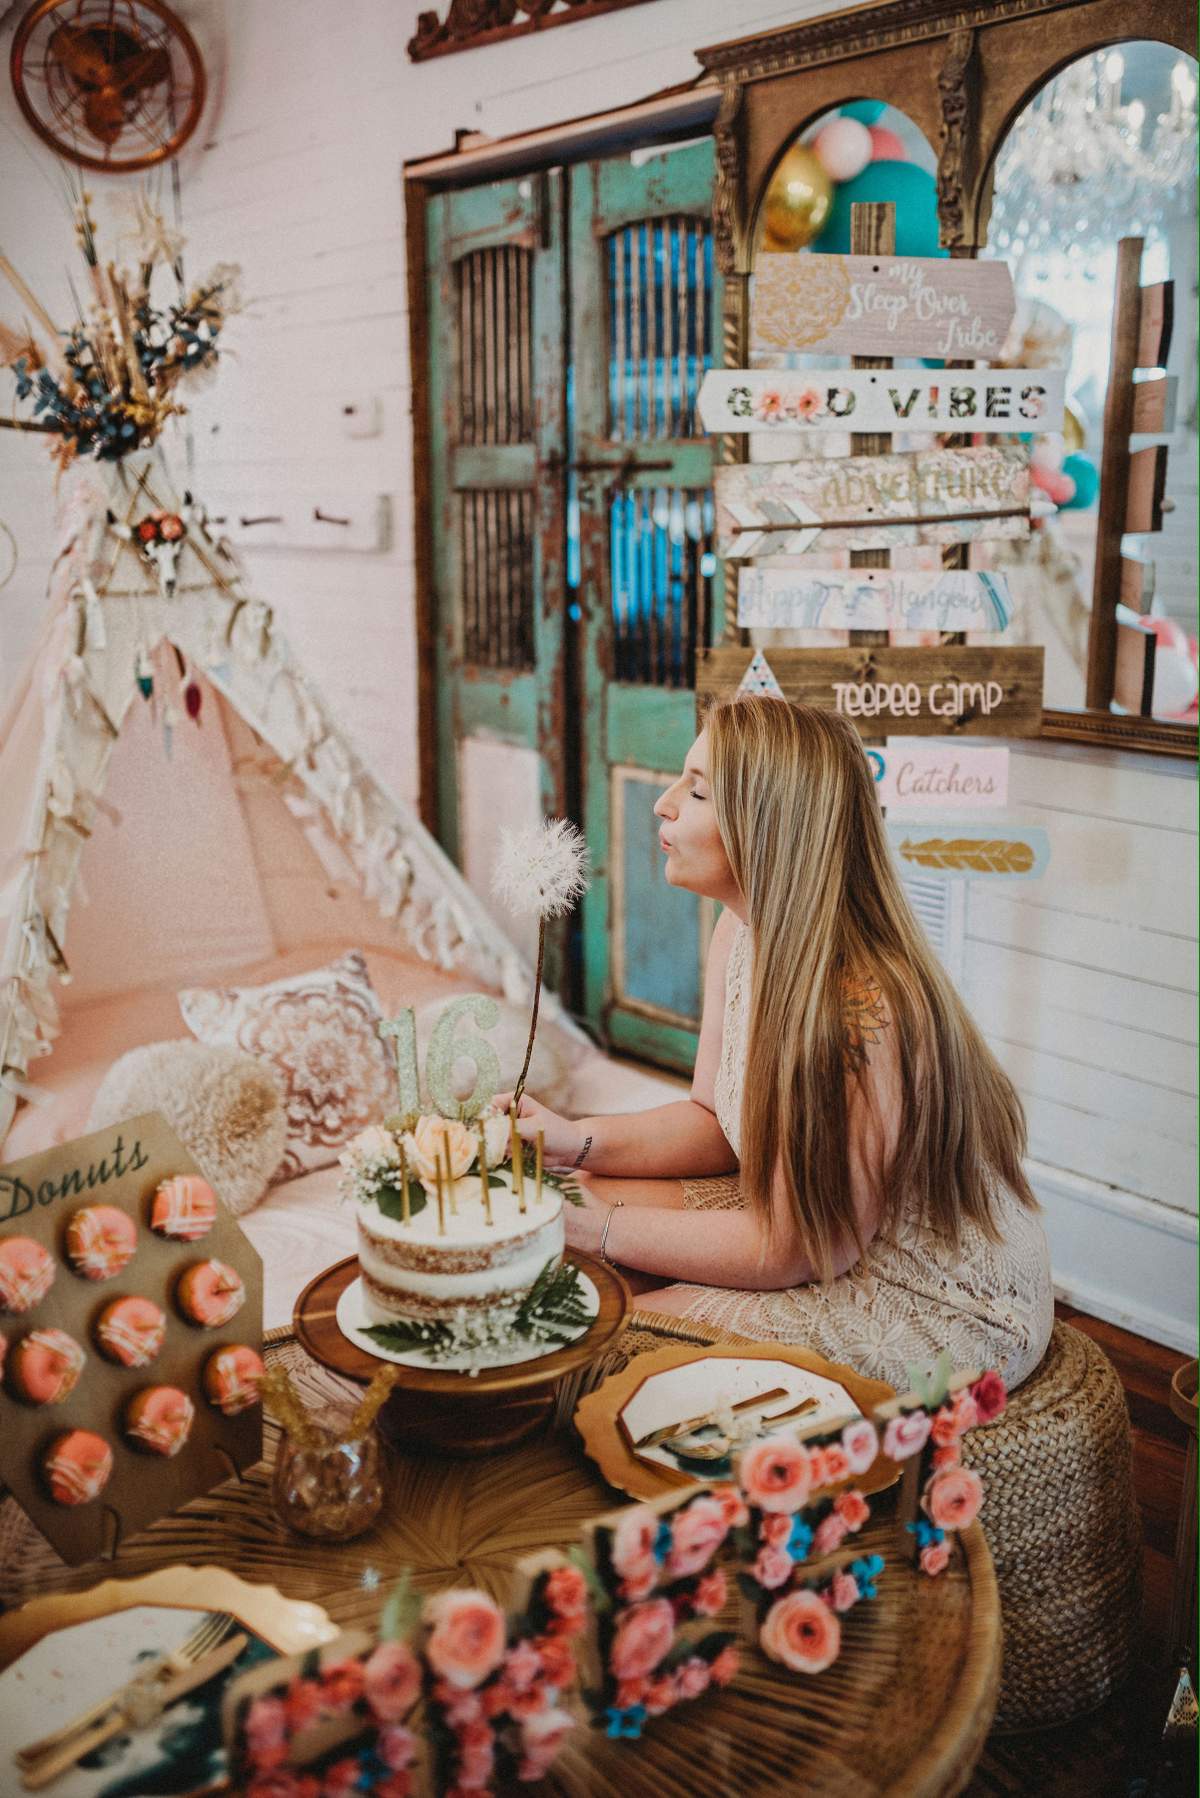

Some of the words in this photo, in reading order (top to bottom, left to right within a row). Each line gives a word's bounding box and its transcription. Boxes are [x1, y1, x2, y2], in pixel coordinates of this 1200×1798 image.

[888, 263, 925, 298] my
[845, 282, 908, 332] Sleep
[915, 287, 970, 326] Over
[936, 315, 998, 354] Tribe
[888, 386, 1047, 419] VIBES
[896, 762, 997, 797] Catchers
[377, 993, 501, 1120] 16
[0, 1136, 149, 1224] Donuts
